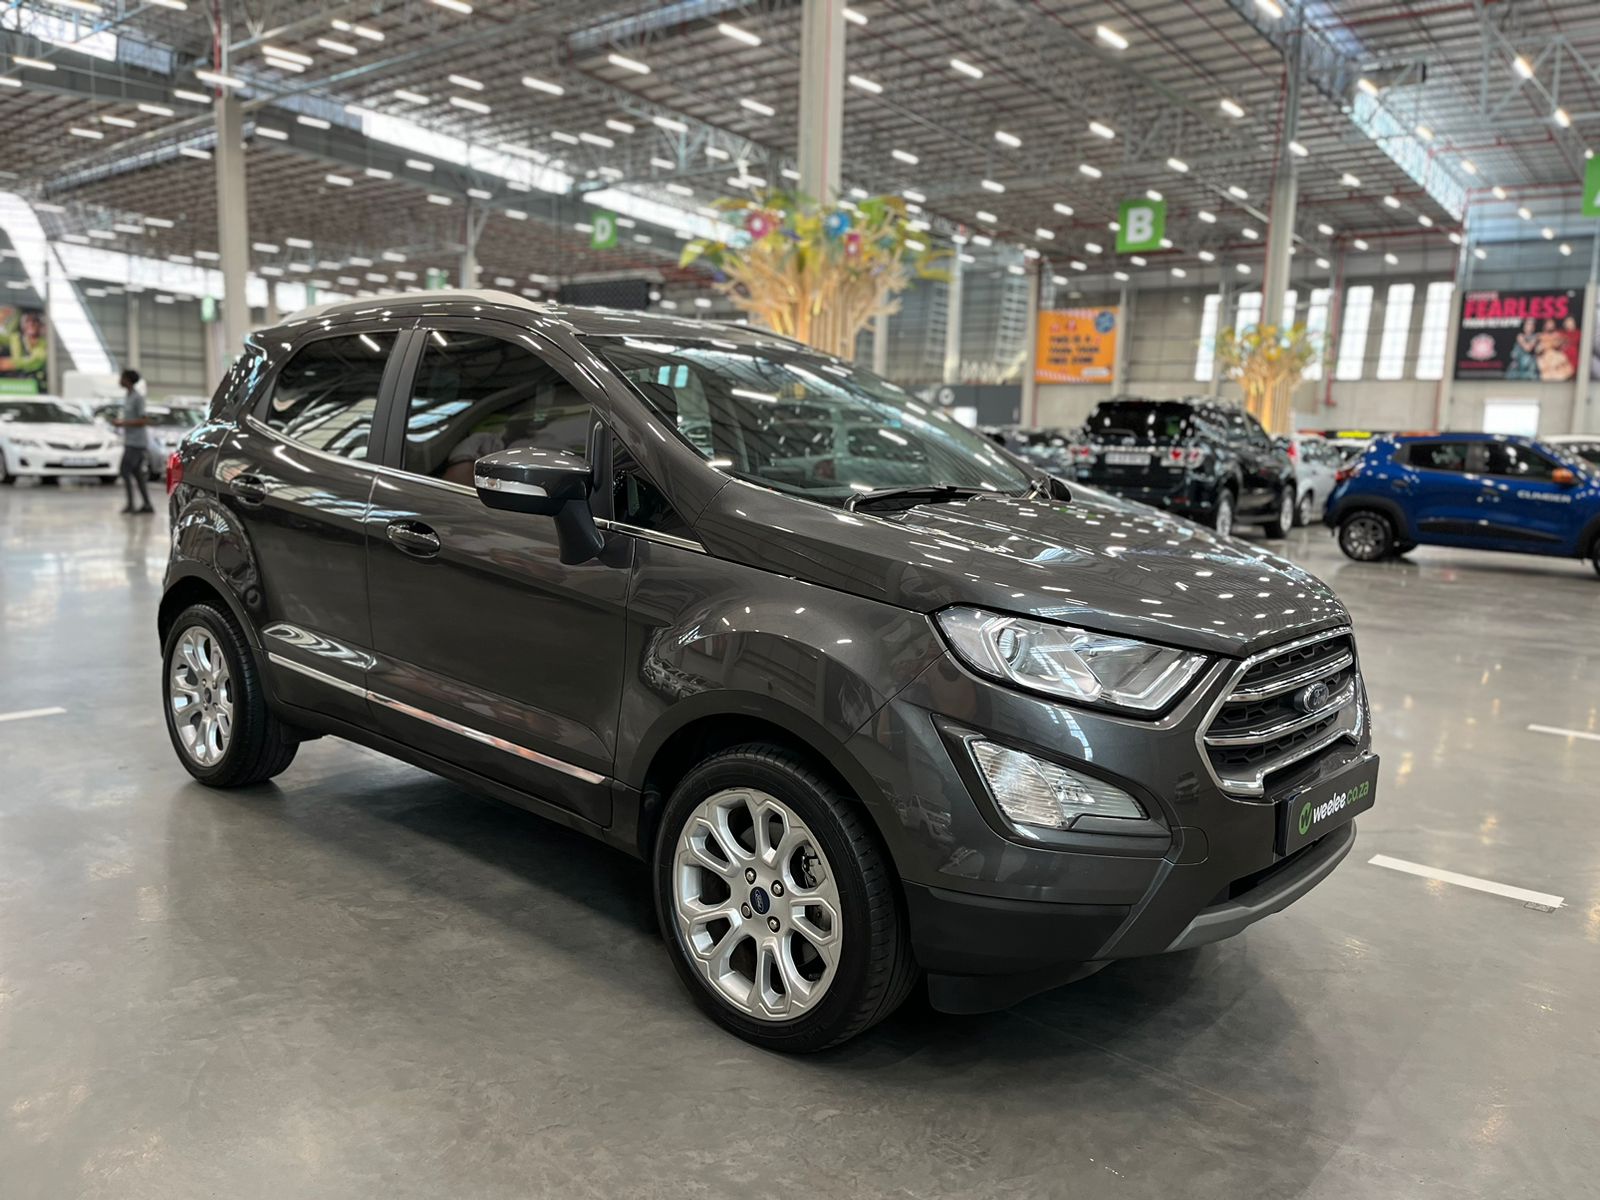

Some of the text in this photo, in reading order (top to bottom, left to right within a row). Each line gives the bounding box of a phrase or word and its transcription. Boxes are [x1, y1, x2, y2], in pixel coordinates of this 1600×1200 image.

[594, 216, 612, 243] D
[1127, 207, 1154, 243] B
[1464, 296, 1569, 320] FEARLESS
